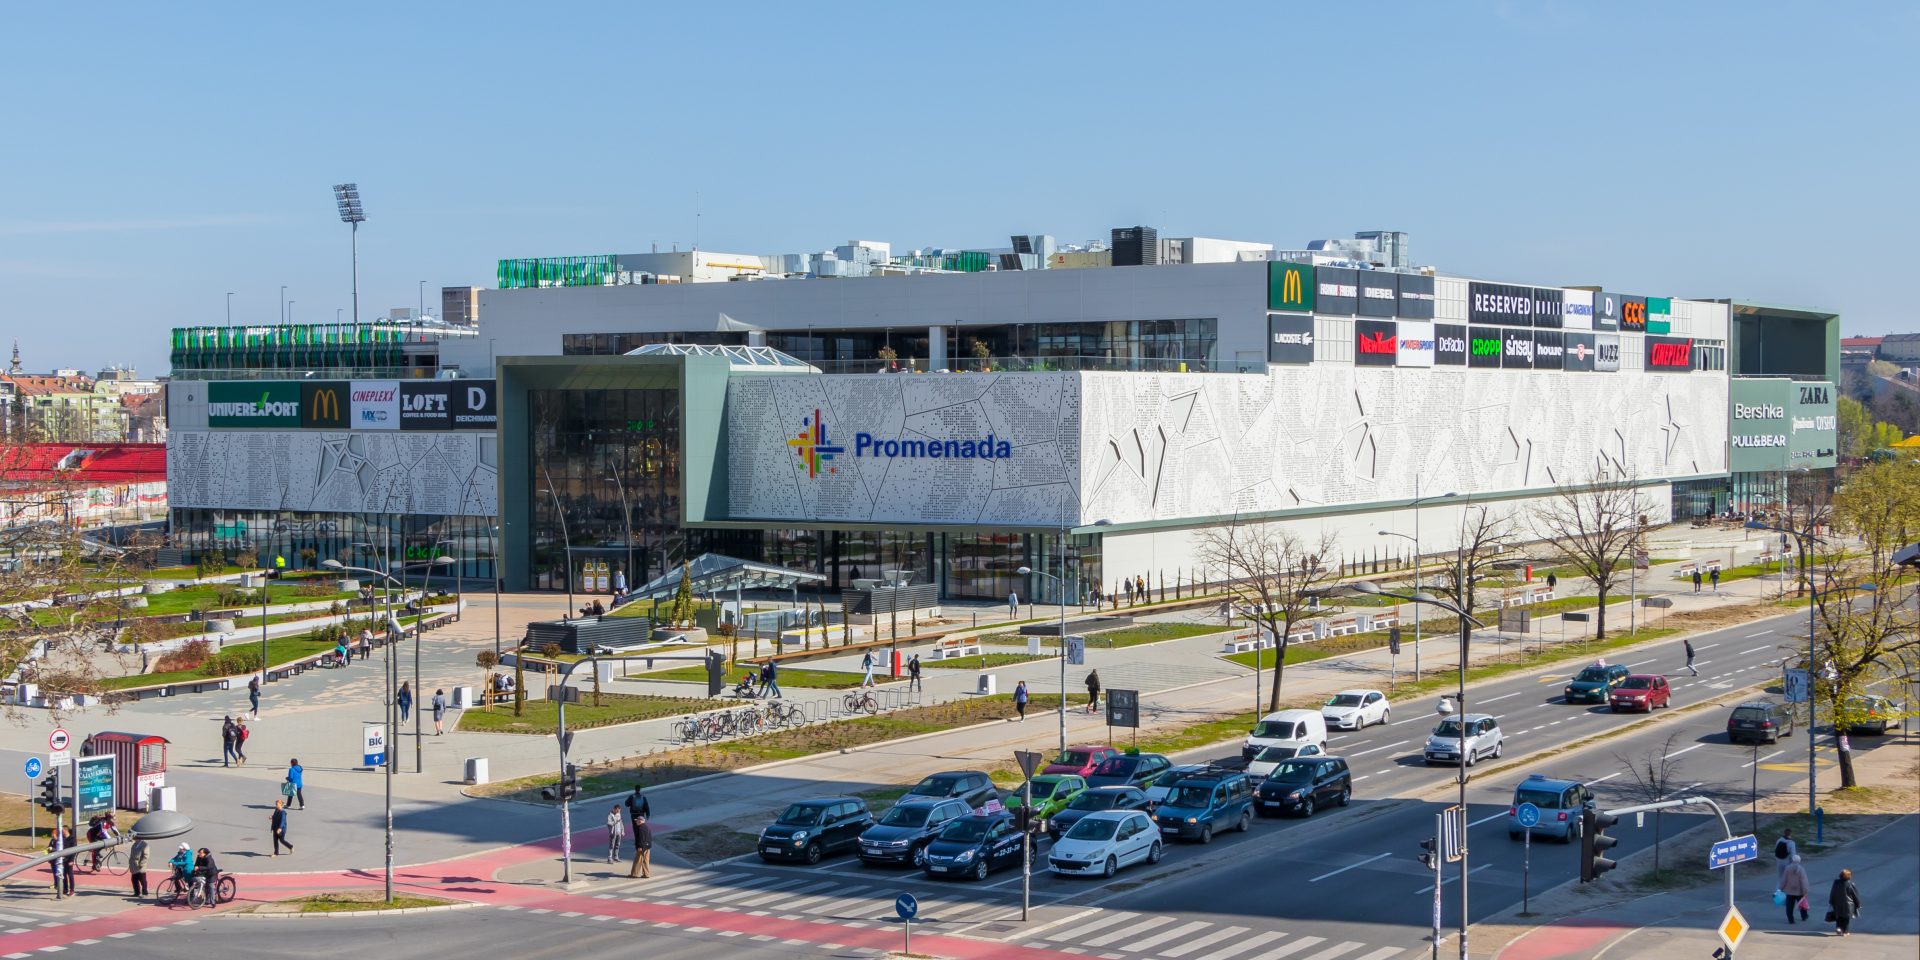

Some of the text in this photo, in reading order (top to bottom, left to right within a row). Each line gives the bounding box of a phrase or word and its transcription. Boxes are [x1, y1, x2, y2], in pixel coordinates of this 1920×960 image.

[1364, 286, 1395, 300] DIESEL
[1475, 293, 1532, 316] RESERVED
[1605, 296, 1613, 317] D
[1624, 302, 1646, 324] CCC
[1274, 332, 1302, 344] LACOSTE
[1405, 339, 1435, 351] INTERSPORT
[1438, 336, 1465, 353] DeFacto
[1472, 338, 1502, 356] CROPP
[1651, 338, 1693, 366] CINEPLEXX
[352, 387, 397, 402] CINEPLEXX
[402, 393, 448, 411] LOFT
[468, 386, 487, 411] D
[1799, 386, 1829, 405] ZARA
[1735, 403, 1784, 419] Bershka
[855, 433, 1012, 459] Promenada
[1732, 434, 1786, 447] PULL&BEAR
[368, 737, 383, 747] BIG
